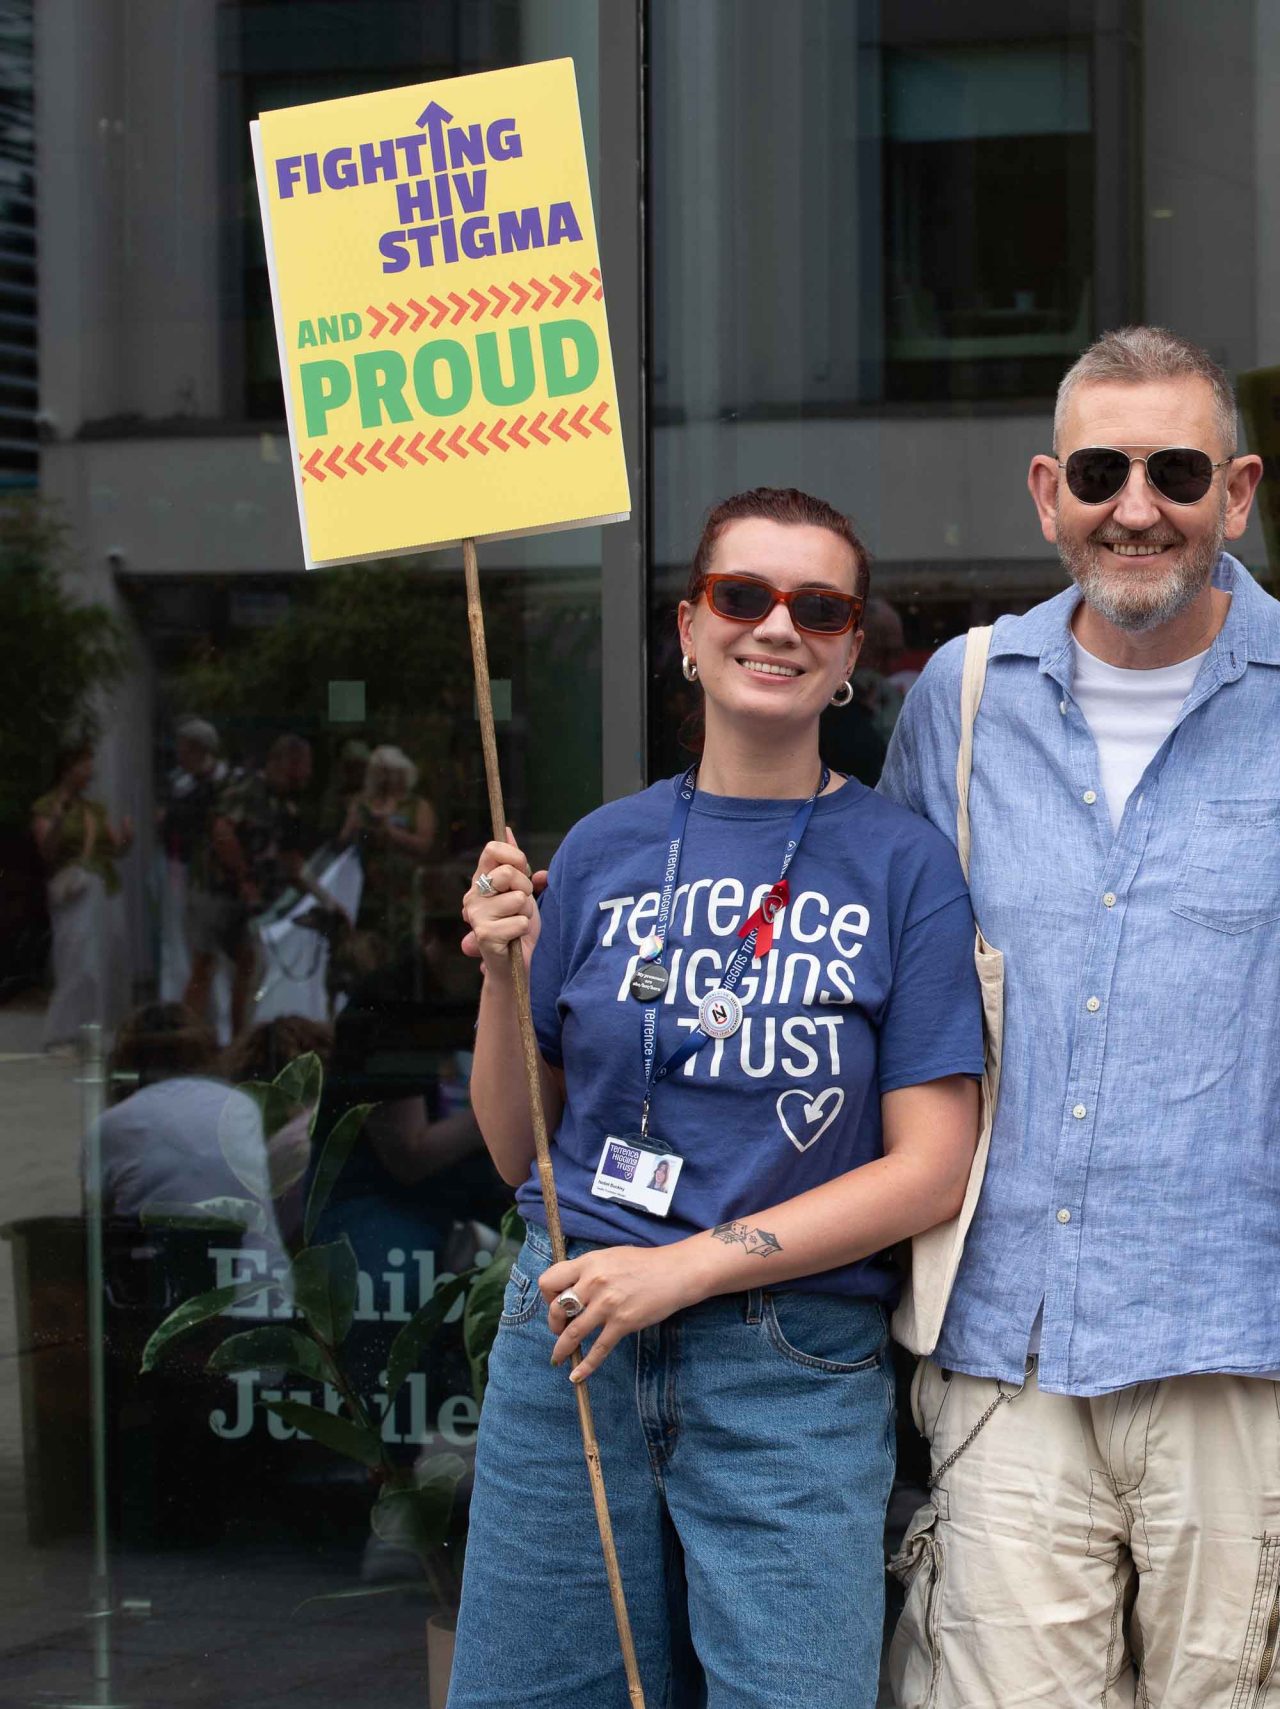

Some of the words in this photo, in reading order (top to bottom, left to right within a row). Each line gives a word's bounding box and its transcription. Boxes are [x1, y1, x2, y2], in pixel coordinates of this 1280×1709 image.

[275, 101, 523, 200] FIGHTING
[395, 168, 488, 224] HIV
[378, 201, 583, 273] STIGMA
[297, 312, 363, 350] AND
[299, 318, 600, 438] PROUD
[665, 838, 681, 882] Terrence
[643, 1008, 656, 1056] Terrence
